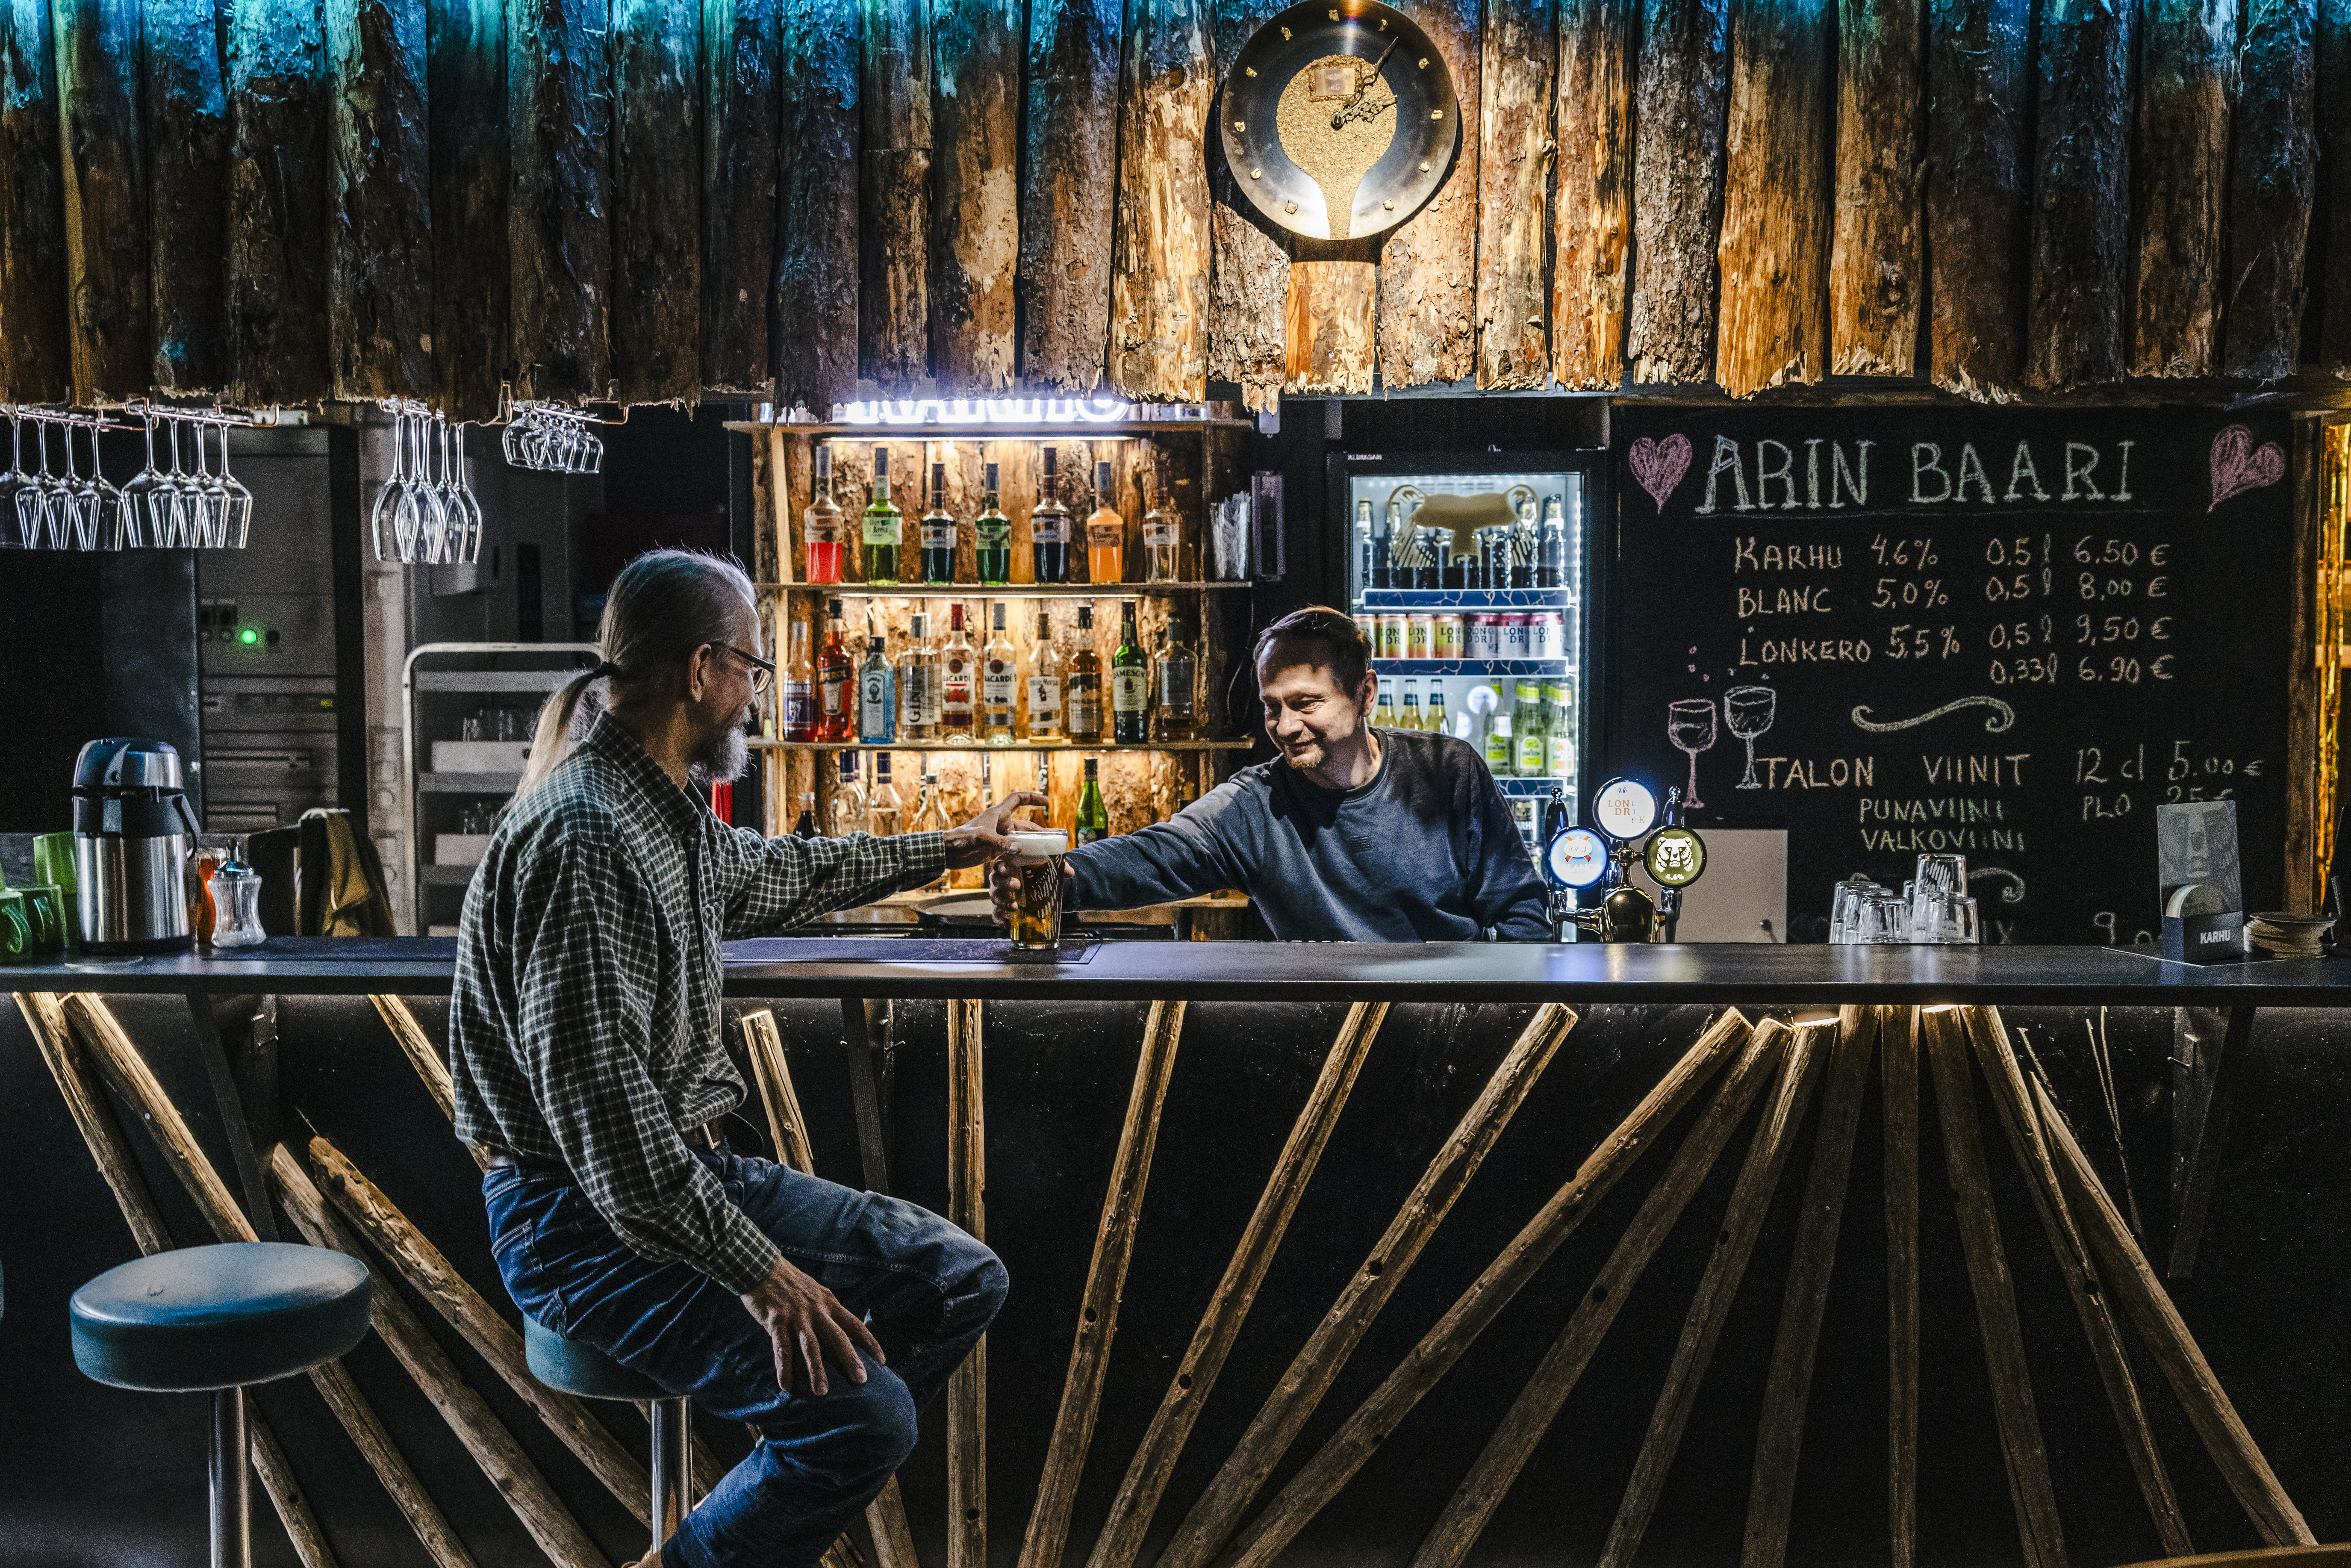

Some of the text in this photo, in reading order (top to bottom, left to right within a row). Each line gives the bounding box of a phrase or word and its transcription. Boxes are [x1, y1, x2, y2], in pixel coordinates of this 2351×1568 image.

[1694, 434, 2135, 514] ARIN BAARI
[1735, 536, 1842, 573] KARHU
[2150, 543, 2171, 566] €
[1737, 585, 1831, 619] BLANC
[2147, 575, 2168, 597] €
[1381, 628, 1399, 636] LON
[1386, 636, 1400, 644] DR
[1409, 627, 1433, 635] LON
[1441, 627, 1461, 636] LON
[1509, 635, 1524, 643] DR
[1738, 638, 1872, 666] LONKERO
[2151, 616, 2173, 640] €
[2150, 654, 2174, 680] €
[1756, 756, 1874, 790] TALON
[1923, 754, 2031, 786] VIINIT
[2076, 747, 2108, 784] 12
[2120, 743, 2144, 781] cl
[2244, 759, 2264, 777] €
[1860, 798, 2003, 823] PUNAVIINI
[2083, 793, 2131, 821] PLO
[1860, 827, 2025, 852] VALKOVIINI
[2200, 929, 2231, 944] KARHU
